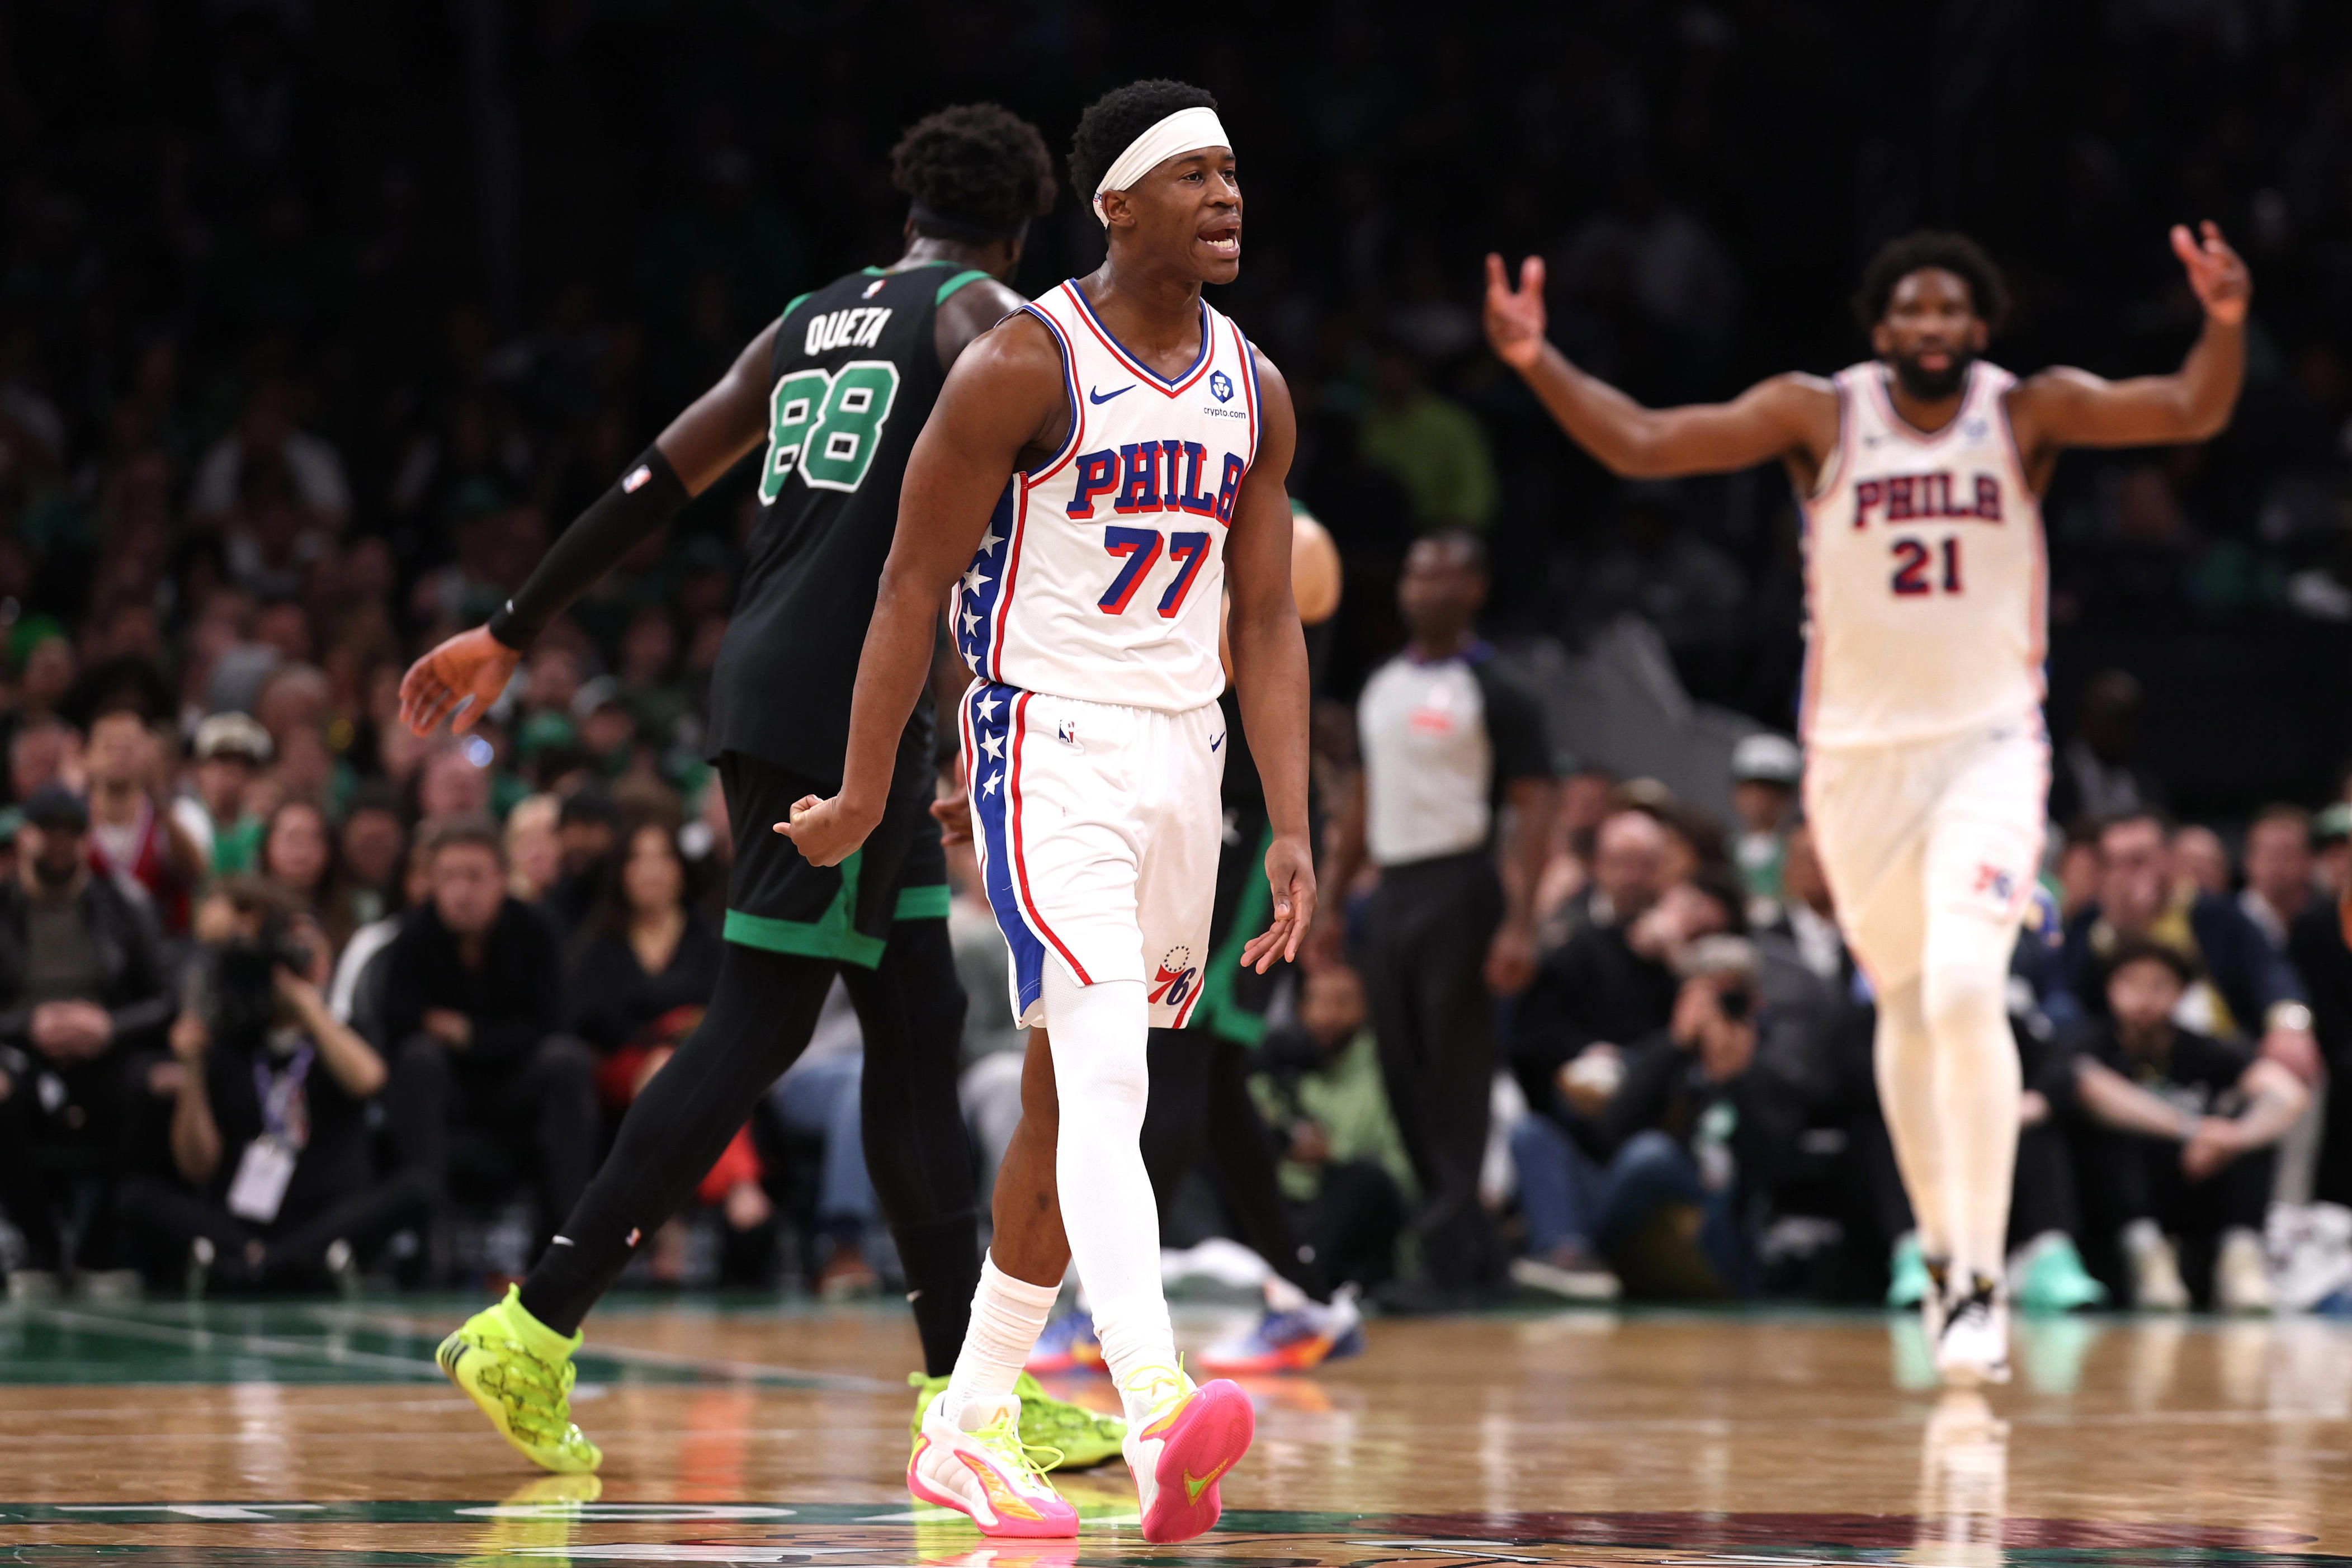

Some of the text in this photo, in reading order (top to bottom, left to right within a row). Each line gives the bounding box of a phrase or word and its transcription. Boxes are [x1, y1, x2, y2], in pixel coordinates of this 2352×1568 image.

[805, 307, 893, 356] QUETA
[758, 360, 900, 507] 88
[1204, 407, 1246, 419] crypto.com
[1066, 440, 1245, 529] PHILA
[1852, 470, 2004, 530] PHILA
[1097, 526, 1212, 618] 77
[1890, 536, 1964, 596] 21
[1148, 964, 1196, 1005] 76
